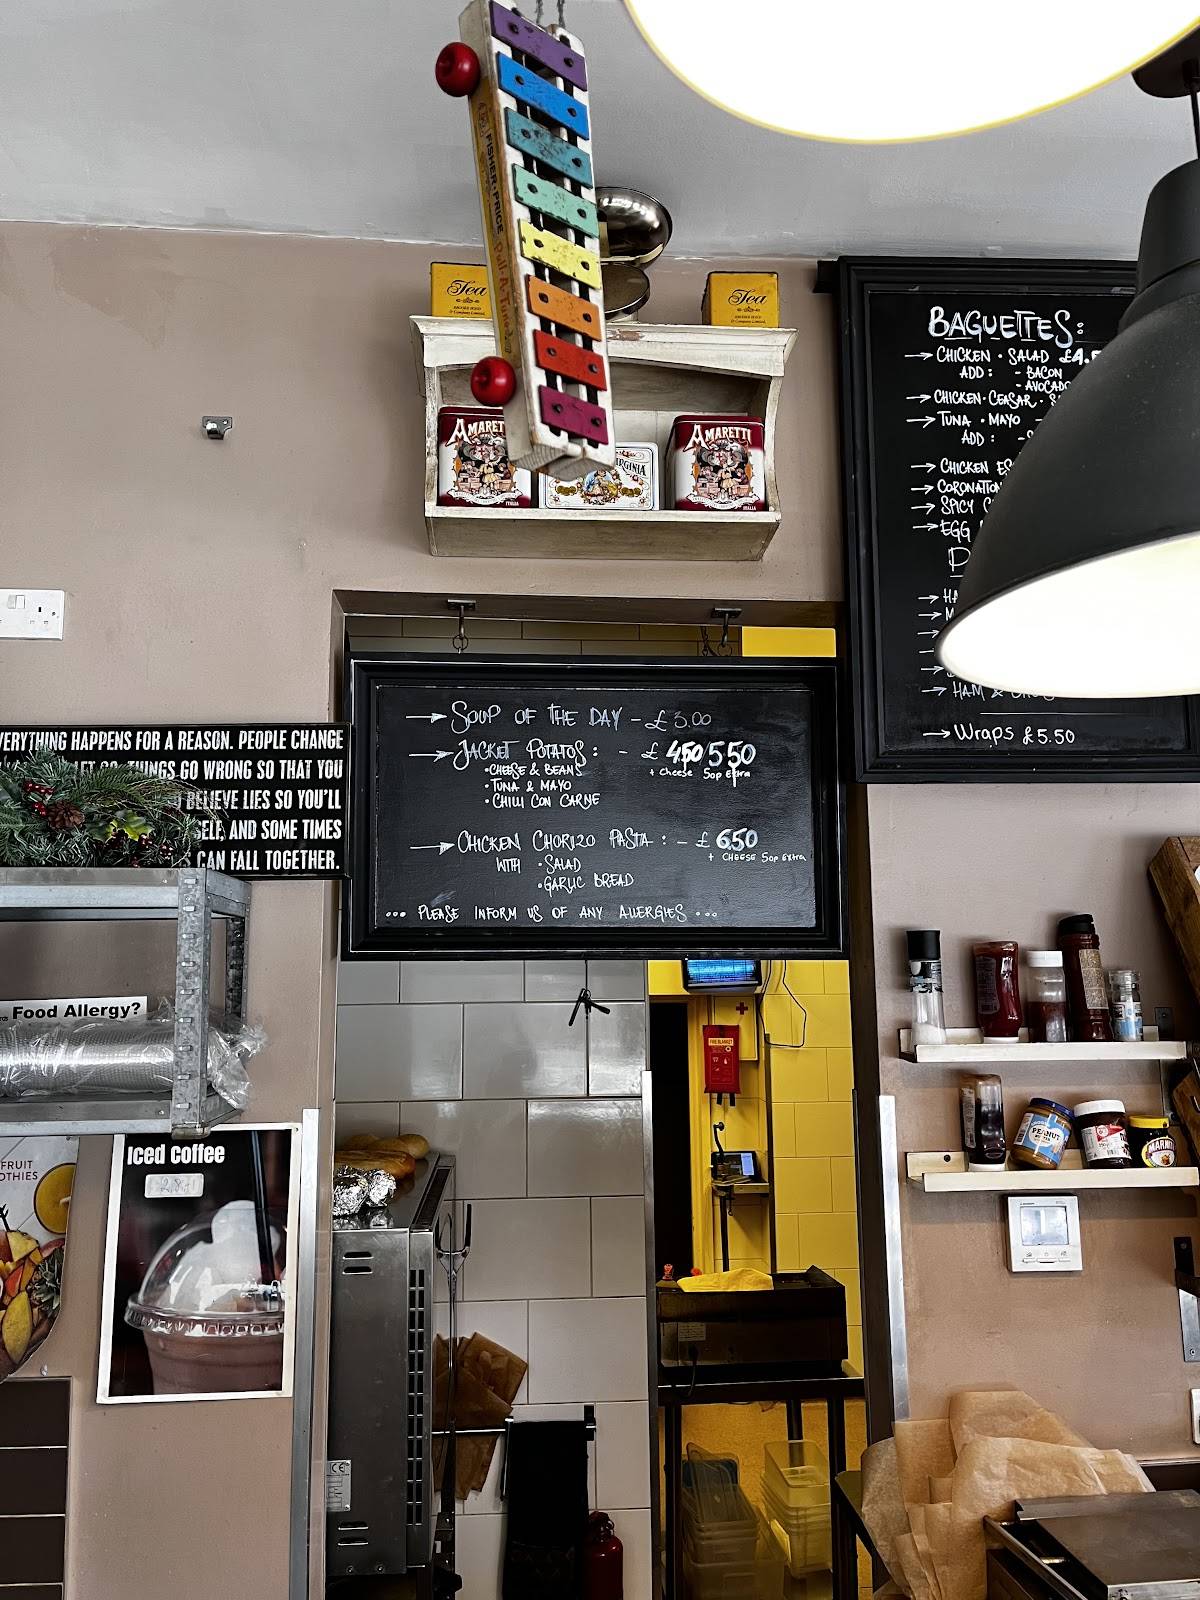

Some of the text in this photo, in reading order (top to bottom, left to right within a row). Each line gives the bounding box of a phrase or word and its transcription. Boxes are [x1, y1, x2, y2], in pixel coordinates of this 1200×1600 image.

[447, 280, 487, 296] Tea
[728, 289, 767, 305] Tea
[936, 345, 991, 363] CHICKEN
[1007, 347, 1050, 366] SALAD
[1026, 366, 1063, 380] BACON
[933, 389, 982, 405] CHICKEN
[988, 389, 1038, 410] CEASAR
[936, 410, 1021, 428] TUNA MAYO
[445, 418, 506, 448] AMARET
[683, 424, 752, 452] AMARETTI
[940, 457, 990, 475] CHICKEN
[940, 495, 974, 515] SPICY
[940, 519, 971, 543] EGG
[952, 681, 986, 701] HAM
[451, 700, 501, 734] SOUP
[514, 708, 537, 725] OF
[547, 703, 578, 726] THE
[589, 707, 623, 731] DAY
[71, 731, 132, 751] HAPPENS
[136, 731, 161, 750] FOR
[164, 731, 174, 750] A
[177, 730, 234, 750] REASON.
[238, 730, 287, 750] PEOPLE
[291, 730, 344, 750] CHANGE
[953, 722, 1075, 746] Wraps £5.50
[452, 739, 520, 770] JACKET
[180, 760, 199, 780] GO
[204, 760, 252, 780] WRONG
[257, 760, 275, 780] SO
[279, 760, 312, 779] THAT
[317, 760, 343, 779] YOU
[489, 763, 583, 779] CHEESE & BEANS
[491, 778, 572, 792] TUNA & MAYO
[186, 790, 239, 810] BELIEVE
[243, 790, 271, 809] LIES
[275, 790, 293, 809] SO
[298, 789, 342, 809] YOU'LL
[530, 793, 552, 808] CON
[559, 793, 600, 810] CARNE
[229, 820, 257, 839] AND
[261, 820, 298, 839] SOME
[302, 820, 342, 839] TIMES
[457, 830, 522, 853] CHICKEN
[197, 850, 226, 870] CAN
[231, 850, 259, 870] FALL
[265, 850, 340, 870] TOGETHER.
[496, 854, 581, 874] WITH SALAD
[543, 872, 635, 897] GARLIC BREAD
[418, 904, 459, 923] PLEASE
[474, 905, 517, 921] INFORM
[527, 905, 543, 923] US
[551, 907, 567, 919] OF
[579, 906, 603, 920] ANY
[13, 1002, 141, 1019] Food Allergy?
[127, 1144, 166, 1165] Iced
[1, 1161, 33, 1169] FRUIT
